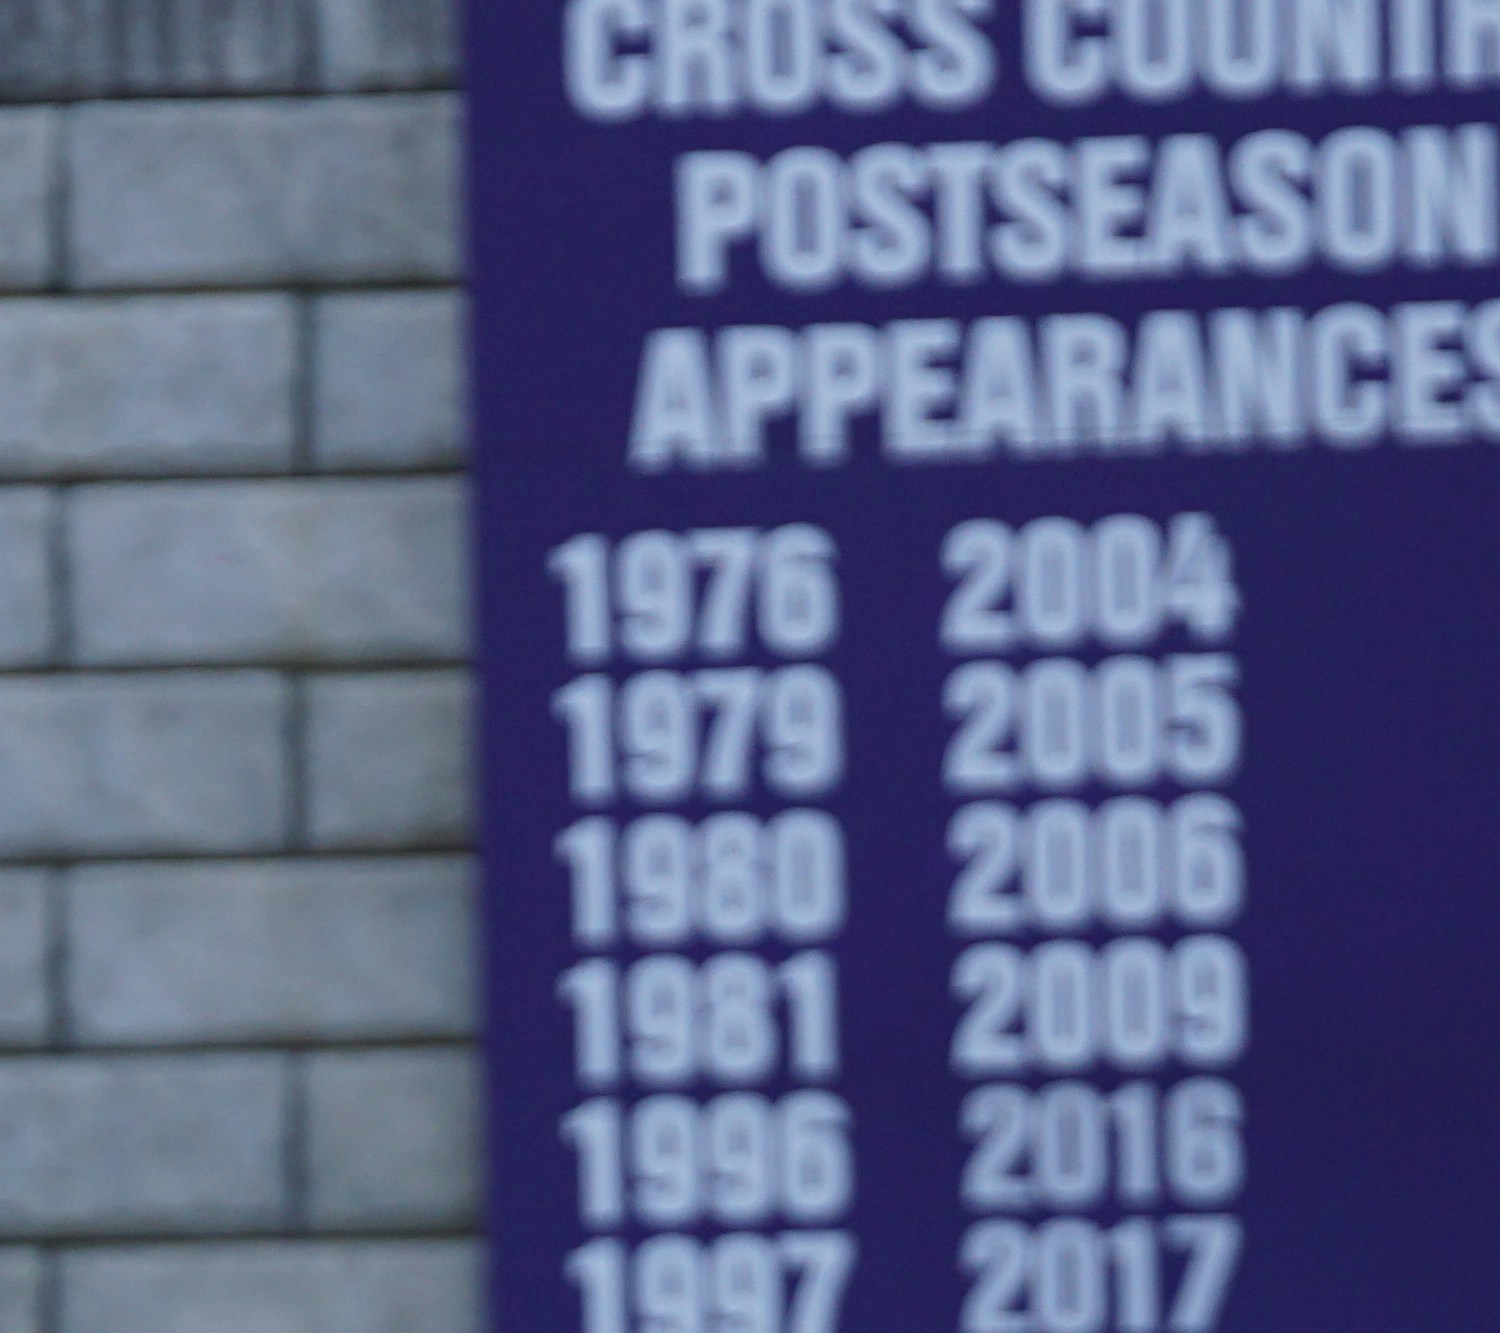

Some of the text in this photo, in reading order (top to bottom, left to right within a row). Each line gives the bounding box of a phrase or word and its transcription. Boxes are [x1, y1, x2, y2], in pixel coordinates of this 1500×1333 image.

[566, 0, 995, 118] CROSS
[676, 125, 1500, 290] POSTSEASON
[551, 526, 838, 658] 1976
[942, 513, 1239, 651] 2004
[555, 664, 843, 801] 1979
[945, 655, 1241, 793] 2005
[557, 809, 845, 945] 1980
[949, 796, 1244, 933] 2006
[561, 952, 837, 1081] 1981
[952, 938, 1246, 1073] 2009
[563, 1090, 852, 1226] 1996
[963, 1078, 1242, 1209] 2016
